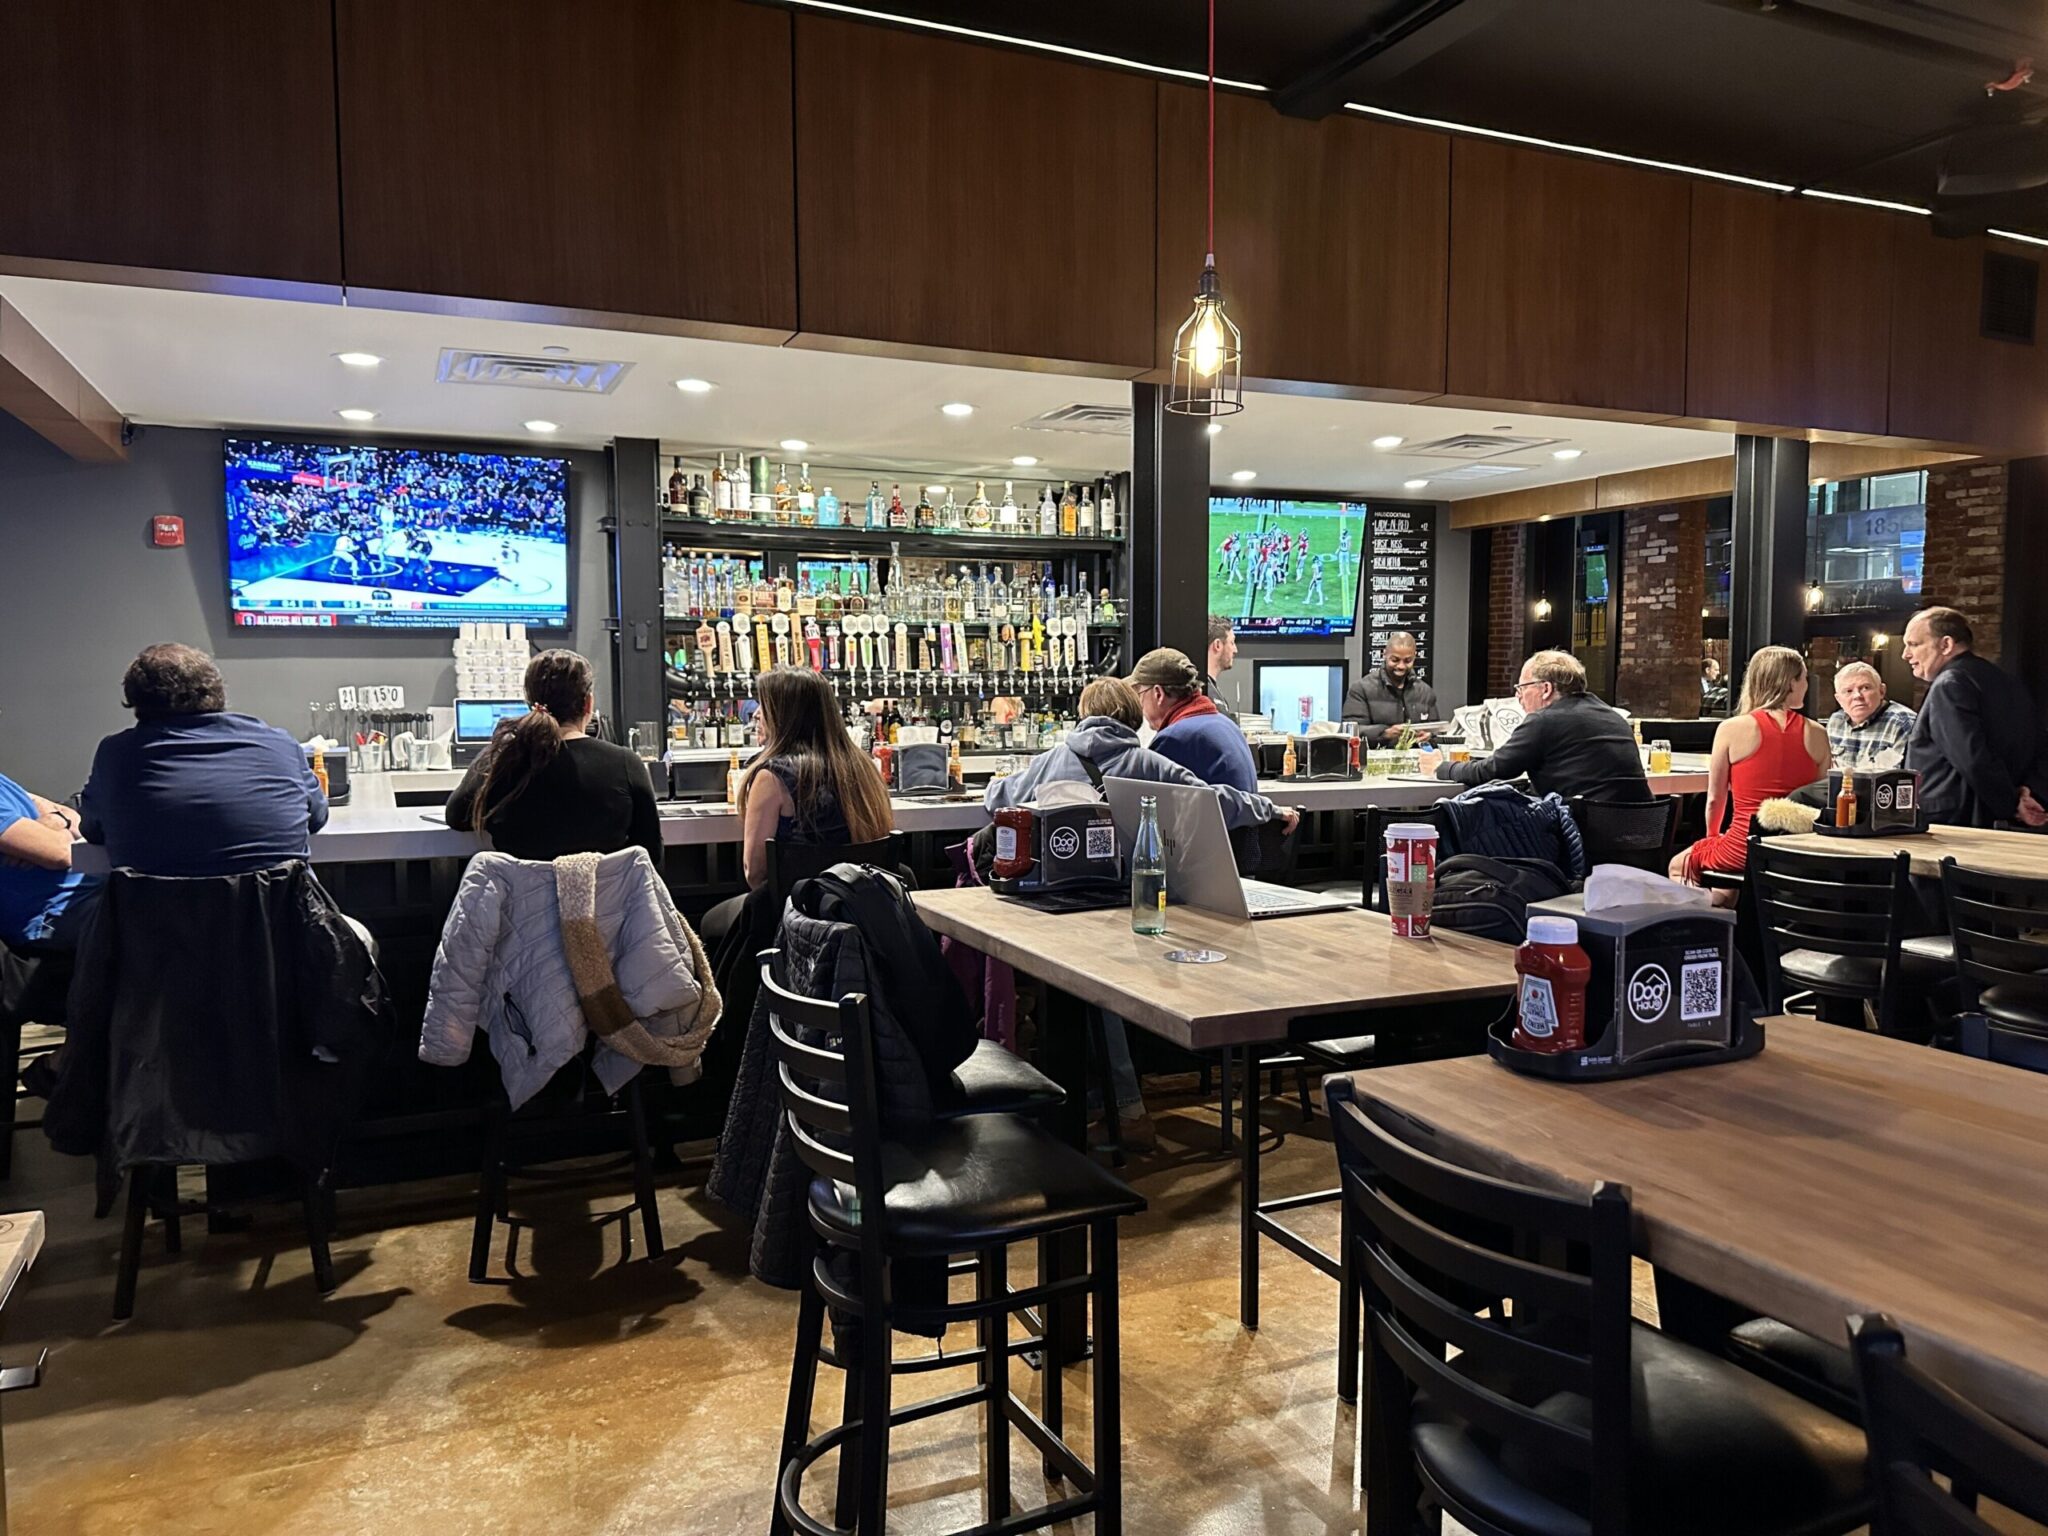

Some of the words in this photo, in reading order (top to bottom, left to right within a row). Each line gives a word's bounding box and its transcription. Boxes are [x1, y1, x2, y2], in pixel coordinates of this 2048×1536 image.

[806, 629, 820, 638] IPA
[342, 689, 354, 703] 21
[1526, 1017, 1547, 1030] HEINZ
